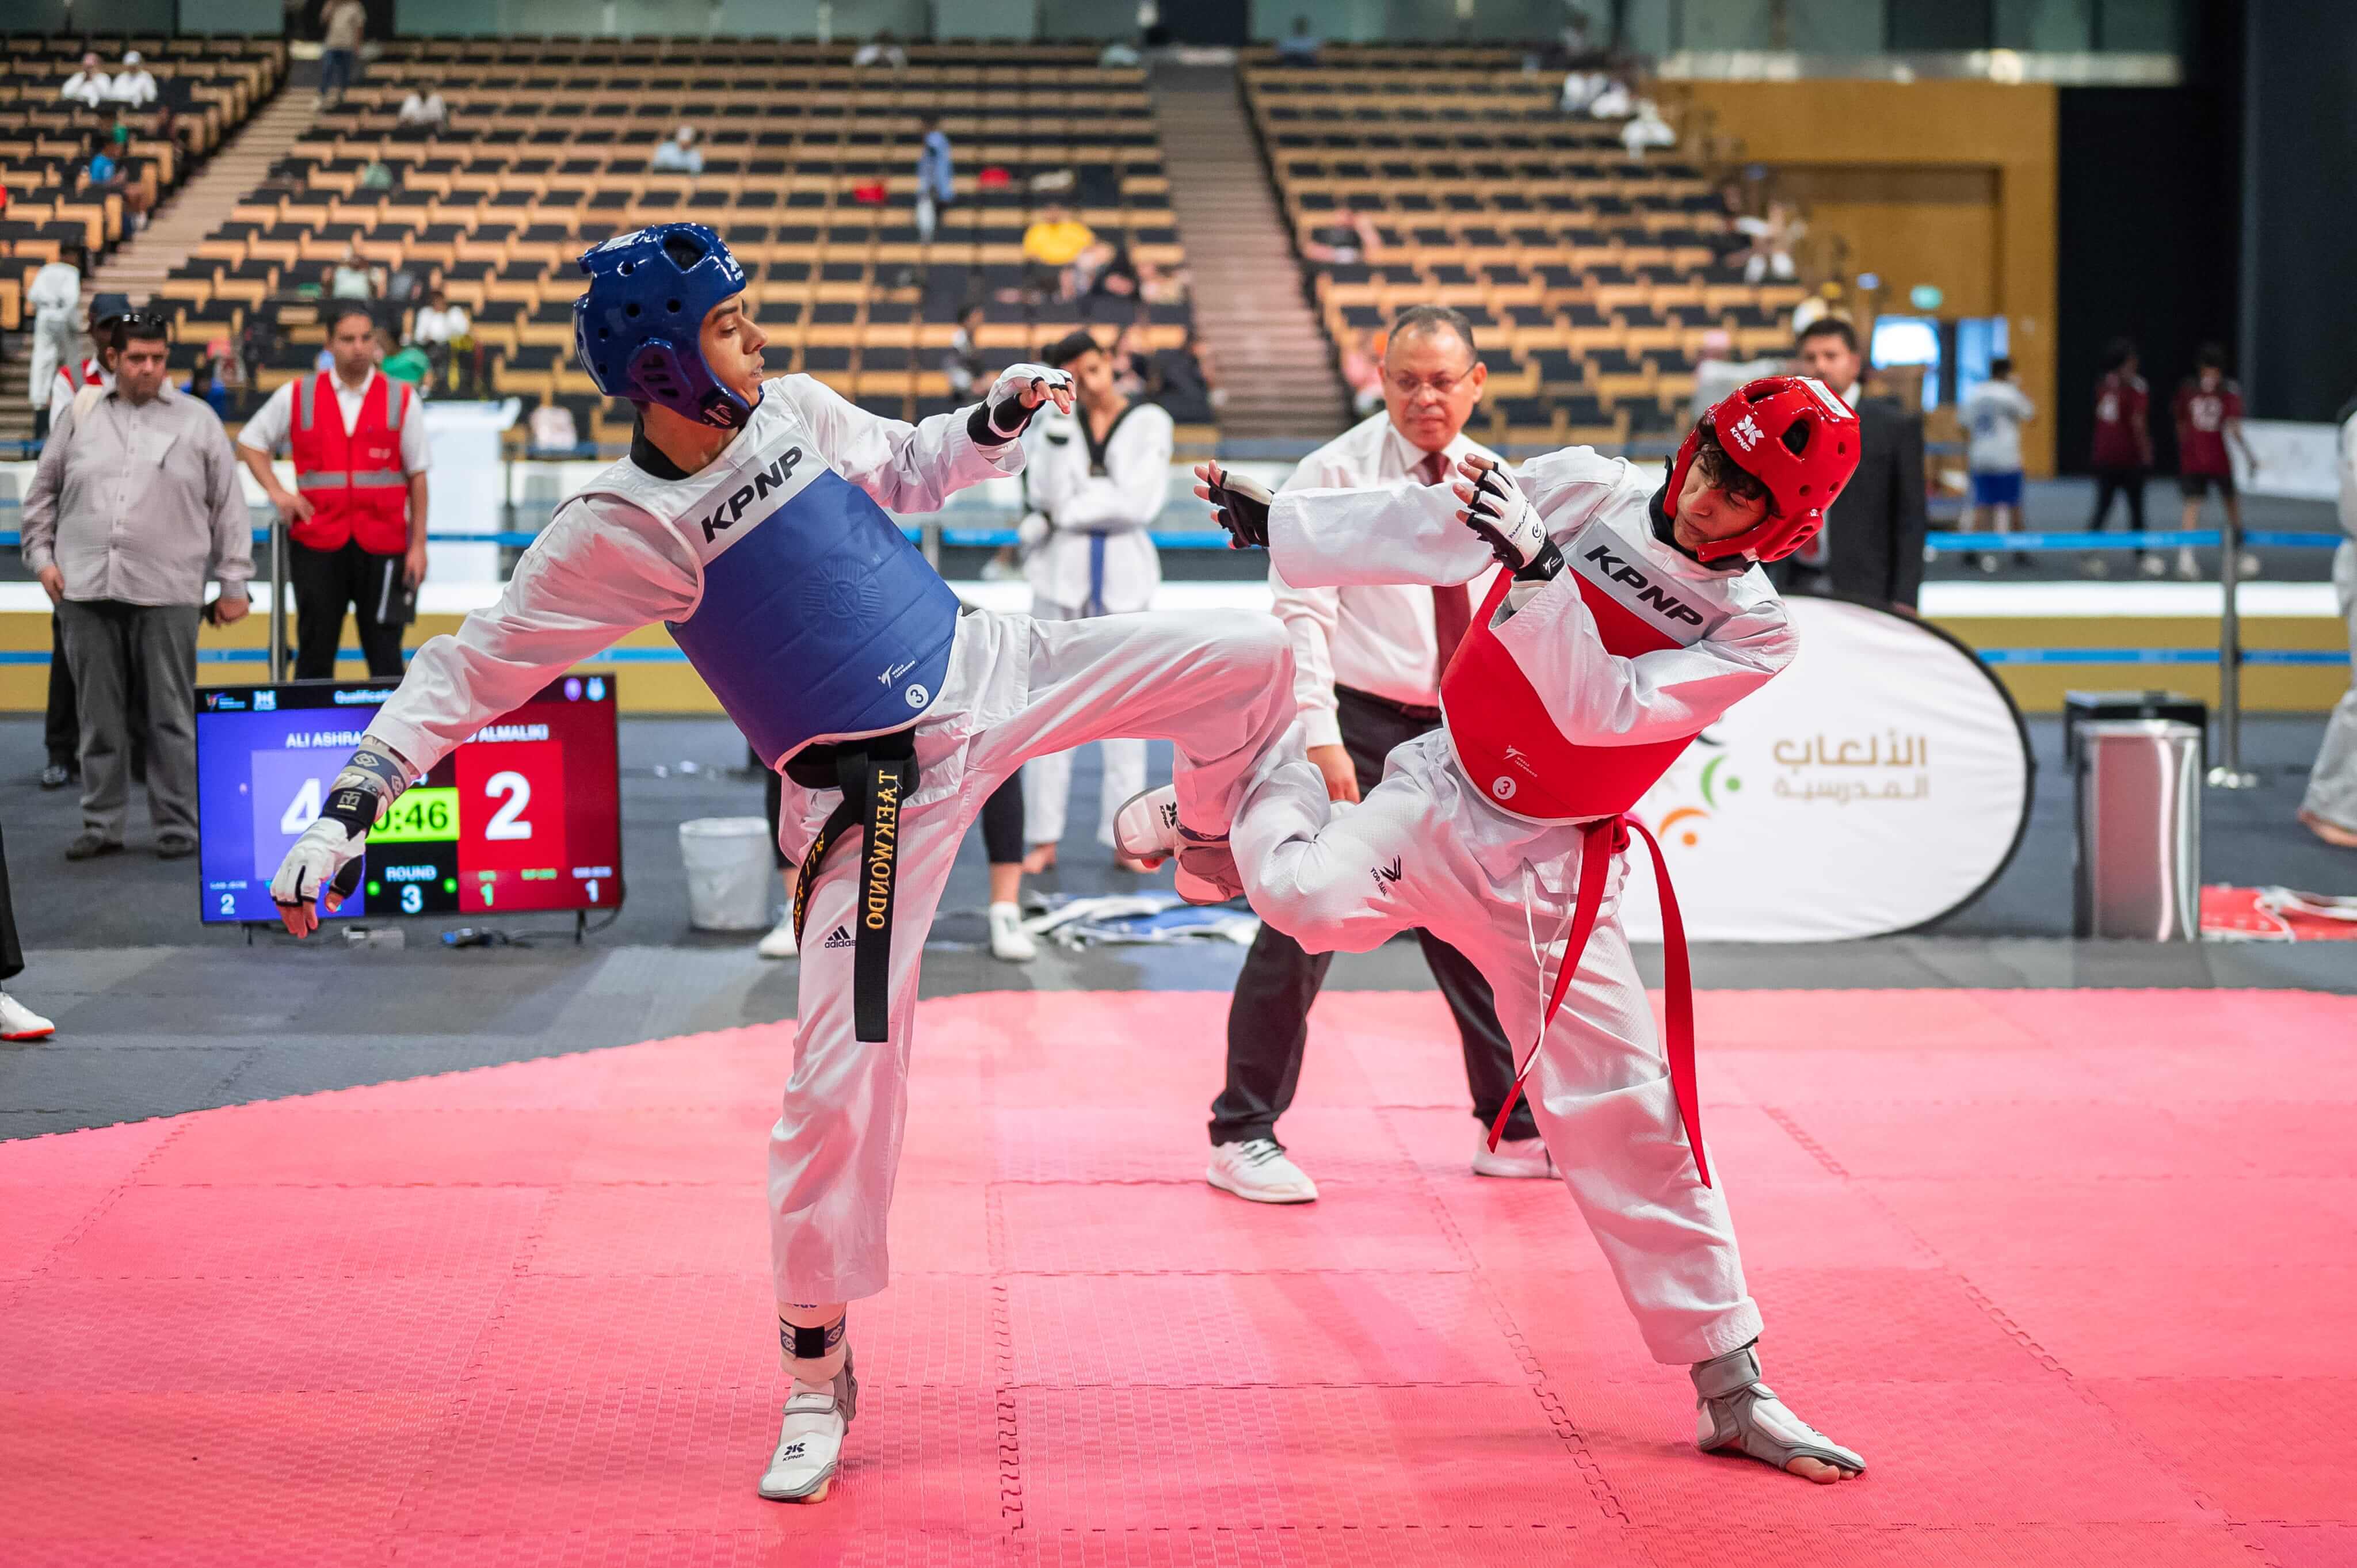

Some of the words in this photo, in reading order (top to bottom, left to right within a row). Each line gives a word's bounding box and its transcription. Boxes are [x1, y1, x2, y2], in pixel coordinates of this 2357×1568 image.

[1730, 426, 1751, 451] KPNP
[701, 447, 802, 544] KPNP
[1584, 544, 1703, 625] KPNP
[910, 689, 924, 703] 3
[286, 733, 310, 747] ALI
[1772, 727, 1925, 774] الألعاب
[1498, 780, 1511, 795] 3
[280, 778, 321, 835] 4
[485, 772, 532, 840] 2
[1160, 806, 1170, 829] KPNP
[386, 865, 437, 882] ROUND
[1371, 867, 1380, 882] TOP
[401, 884, 423, 914] 3
[480, 883, 493, 906] 1
[585, 879, 598, 902] 1
[220, 894, 235, 914] 2
[825, 938, 856, 948] adidas
[783, 1453, 804, 1462] KPNP
